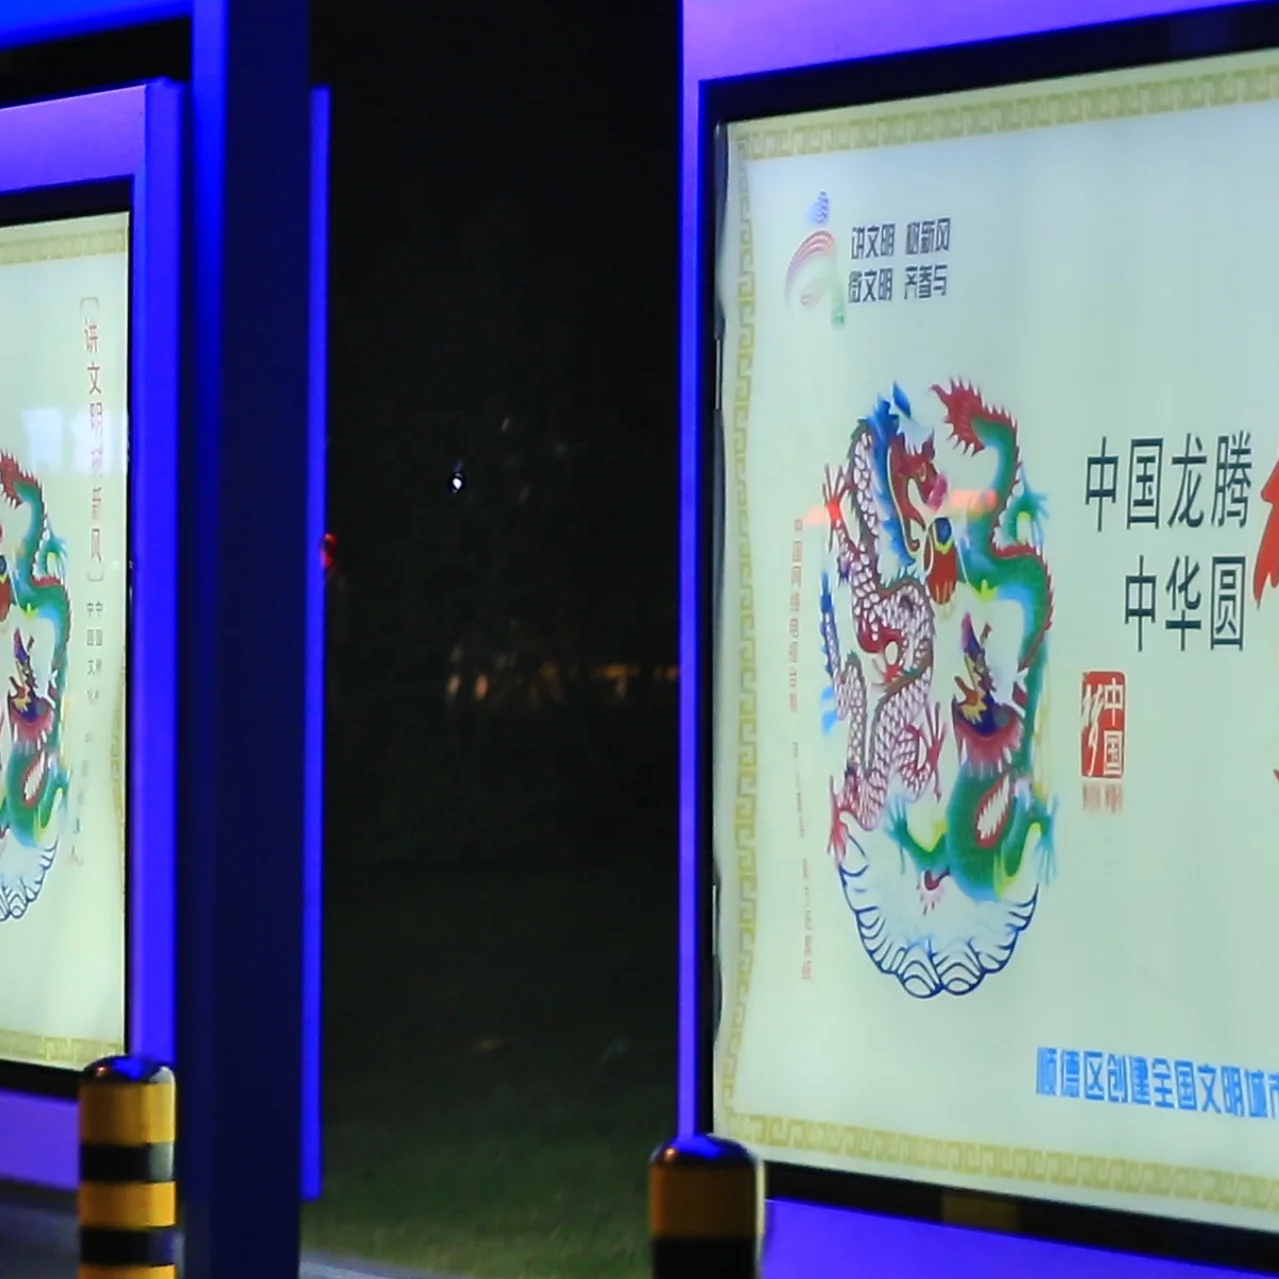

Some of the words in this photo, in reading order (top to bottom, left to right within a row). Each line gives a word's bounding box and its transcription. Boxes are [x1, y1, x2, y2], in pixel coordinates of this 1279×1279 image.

[1084, 430, 1253, 532] 中国龙腾
[1124, 554, 1247, 652] 中华圆
